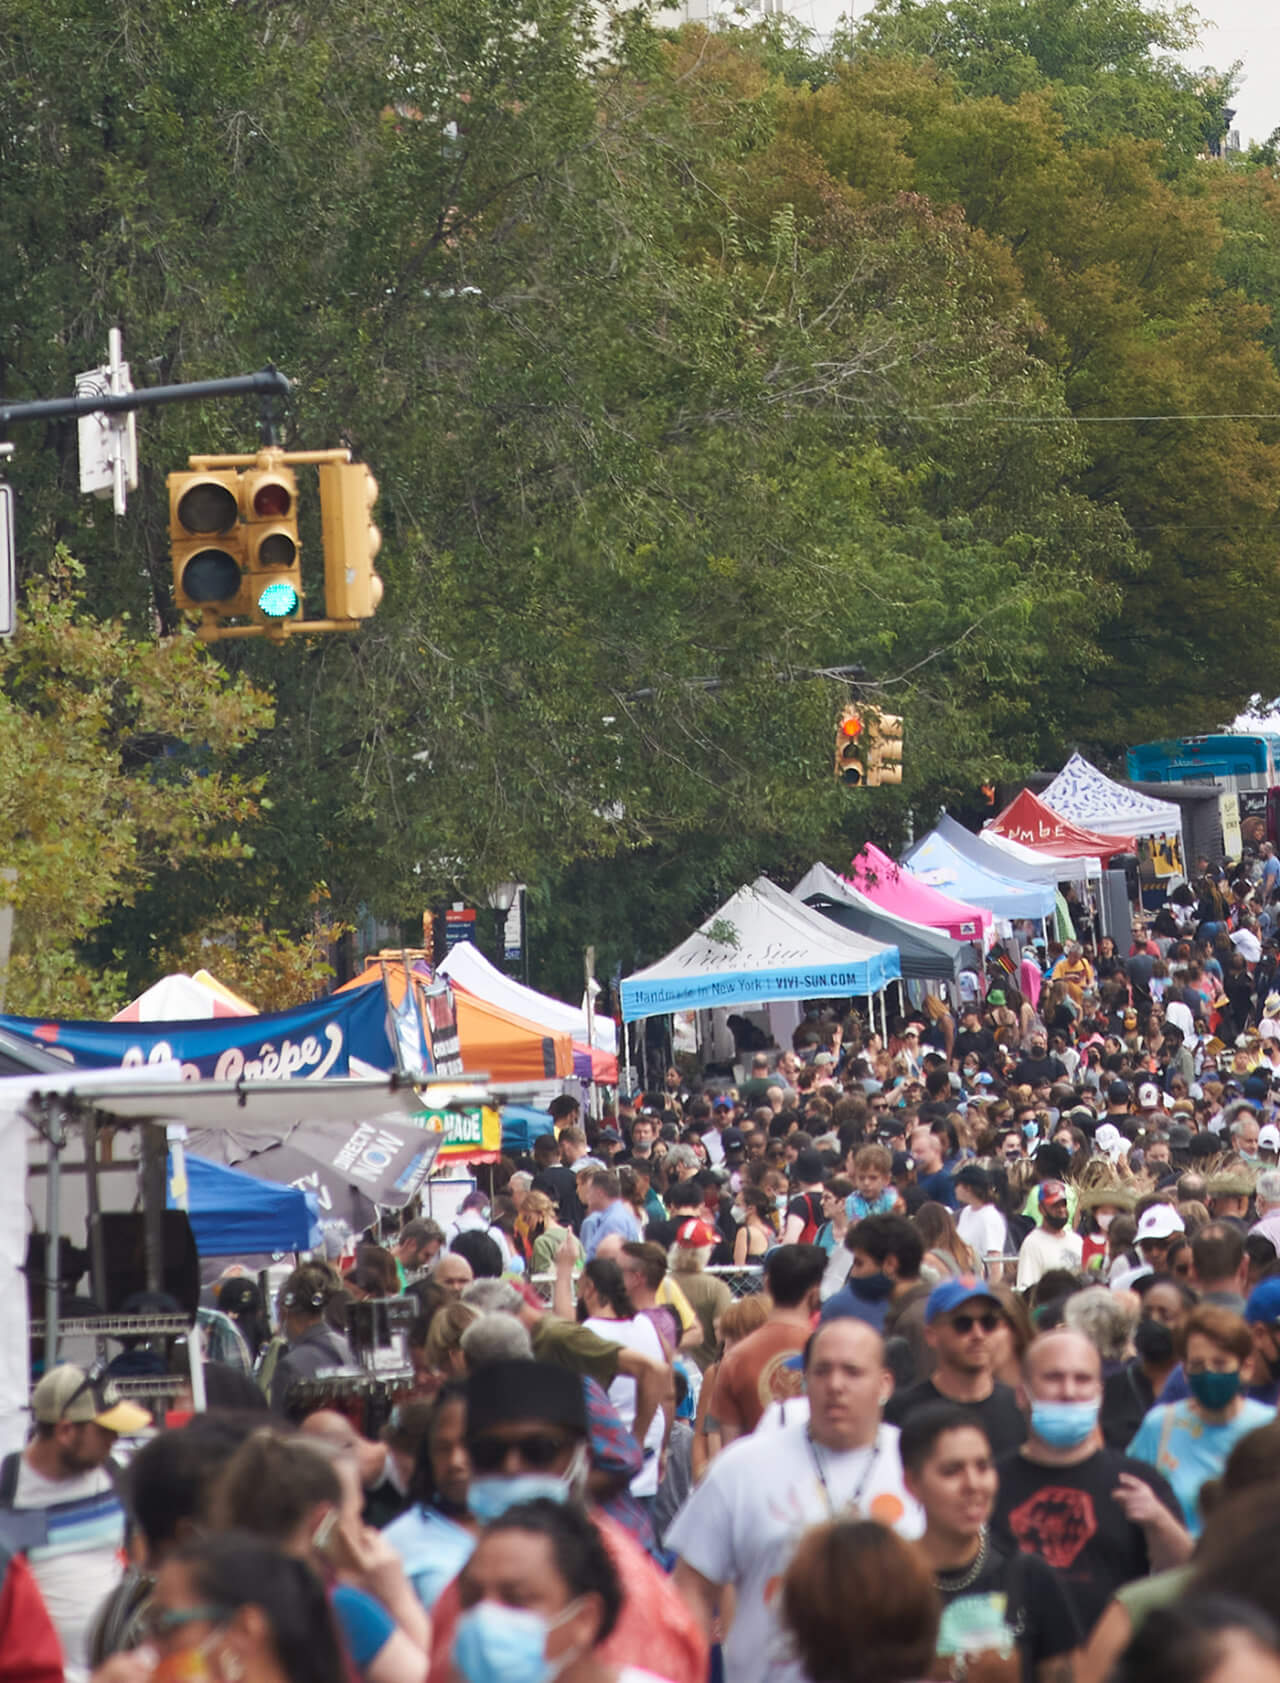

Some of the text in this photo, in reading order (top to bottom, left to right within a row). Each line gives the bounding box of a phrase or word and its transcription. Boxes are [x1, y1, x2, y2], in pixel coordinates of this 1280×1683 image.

[711, 982, 736, 996] New
[738, 978, 762, 992] York
[775, 973, 856, 989] VIVI-SUN.COM
[332, 1121, 377, 1170] DIRECTV
[350, 1129, 405, 1183] NOW
